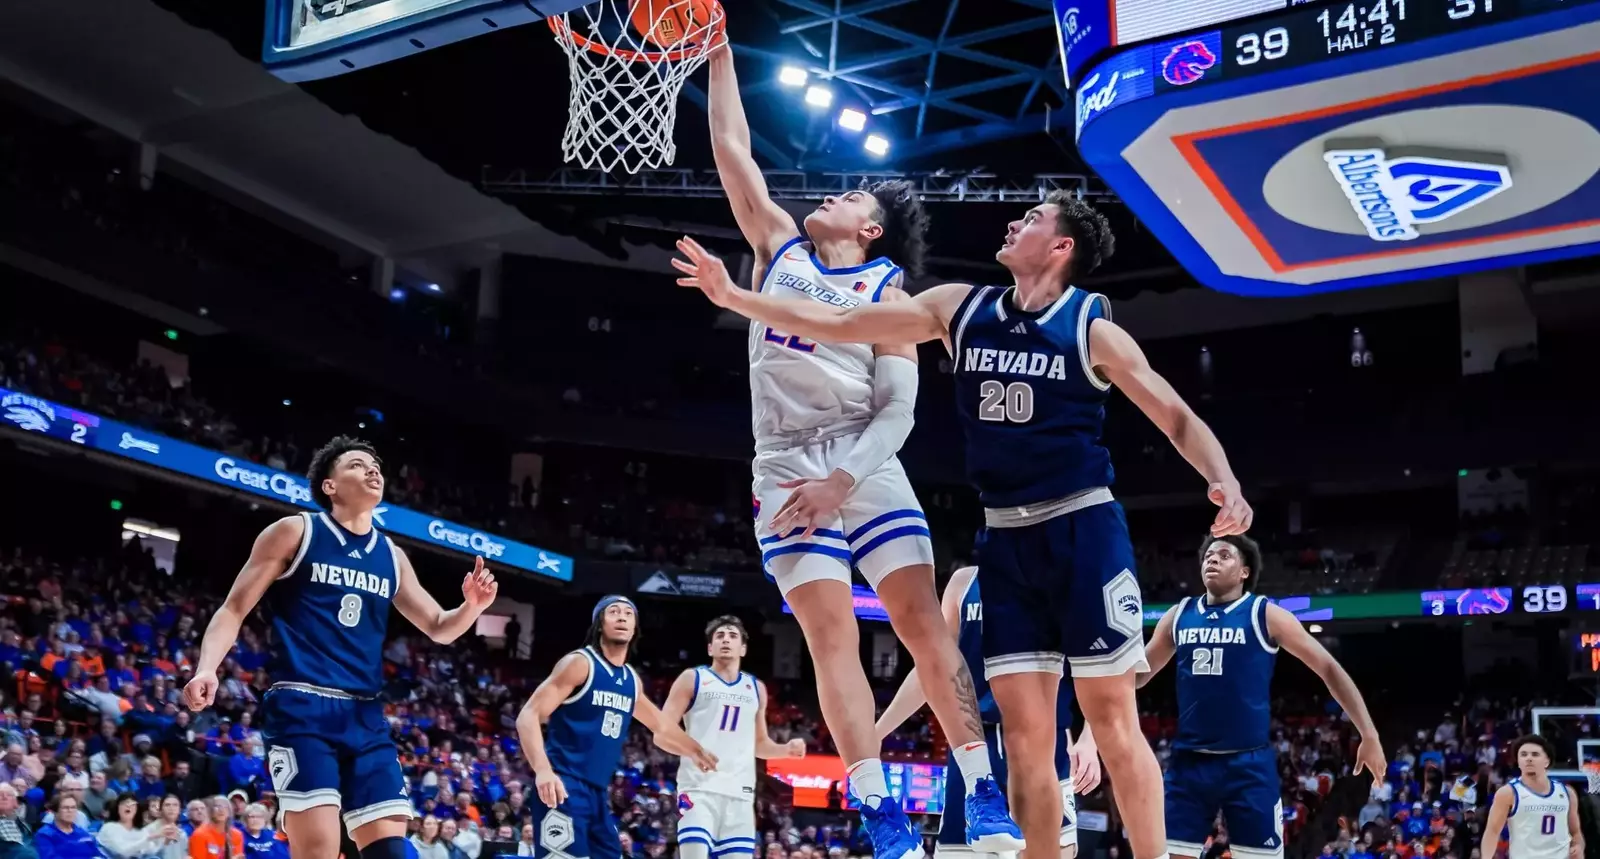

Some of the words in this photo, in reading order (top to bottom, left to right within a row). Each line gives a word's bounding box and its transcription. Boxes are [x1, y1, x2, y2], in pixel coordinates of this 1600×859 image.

[1316, 0, 1405, 37] 14:41
[1236, 26, 1289, 66] 39
[1327, 28, 1374, 54] HALF
[1380, 23, 1396, 45] 2
[1332, 153, 1407, 238] Albertsons
[775, 272, 860, 310] BRONCOS
[965, 347, 1066, 380] NEVADA
[979, 380, 1034, 423] 20
[71, 423, 87, 444] 2
[215, 457, 270, 491] Great
[270, 473, 312, 503] Clips
[428, 520, 470, 548] Great
[470, 532, 506, 558] Clips
[310, 562, 390, 599] NEVADA
[338, 593, 363, 627] 8
[1118, 594, 1140, 606] NEVA
[1431, 600, 1445, 616] 3
[1523, 585, 1567, 612] 39
[1178, 627, 1246, 646] NEVADA
[1192, 647, 1224, 676] 21
[601, 710, 623, 739] 53
[719, 704, 741, 732] 11
[1541, 815, 1556, 835] 0
